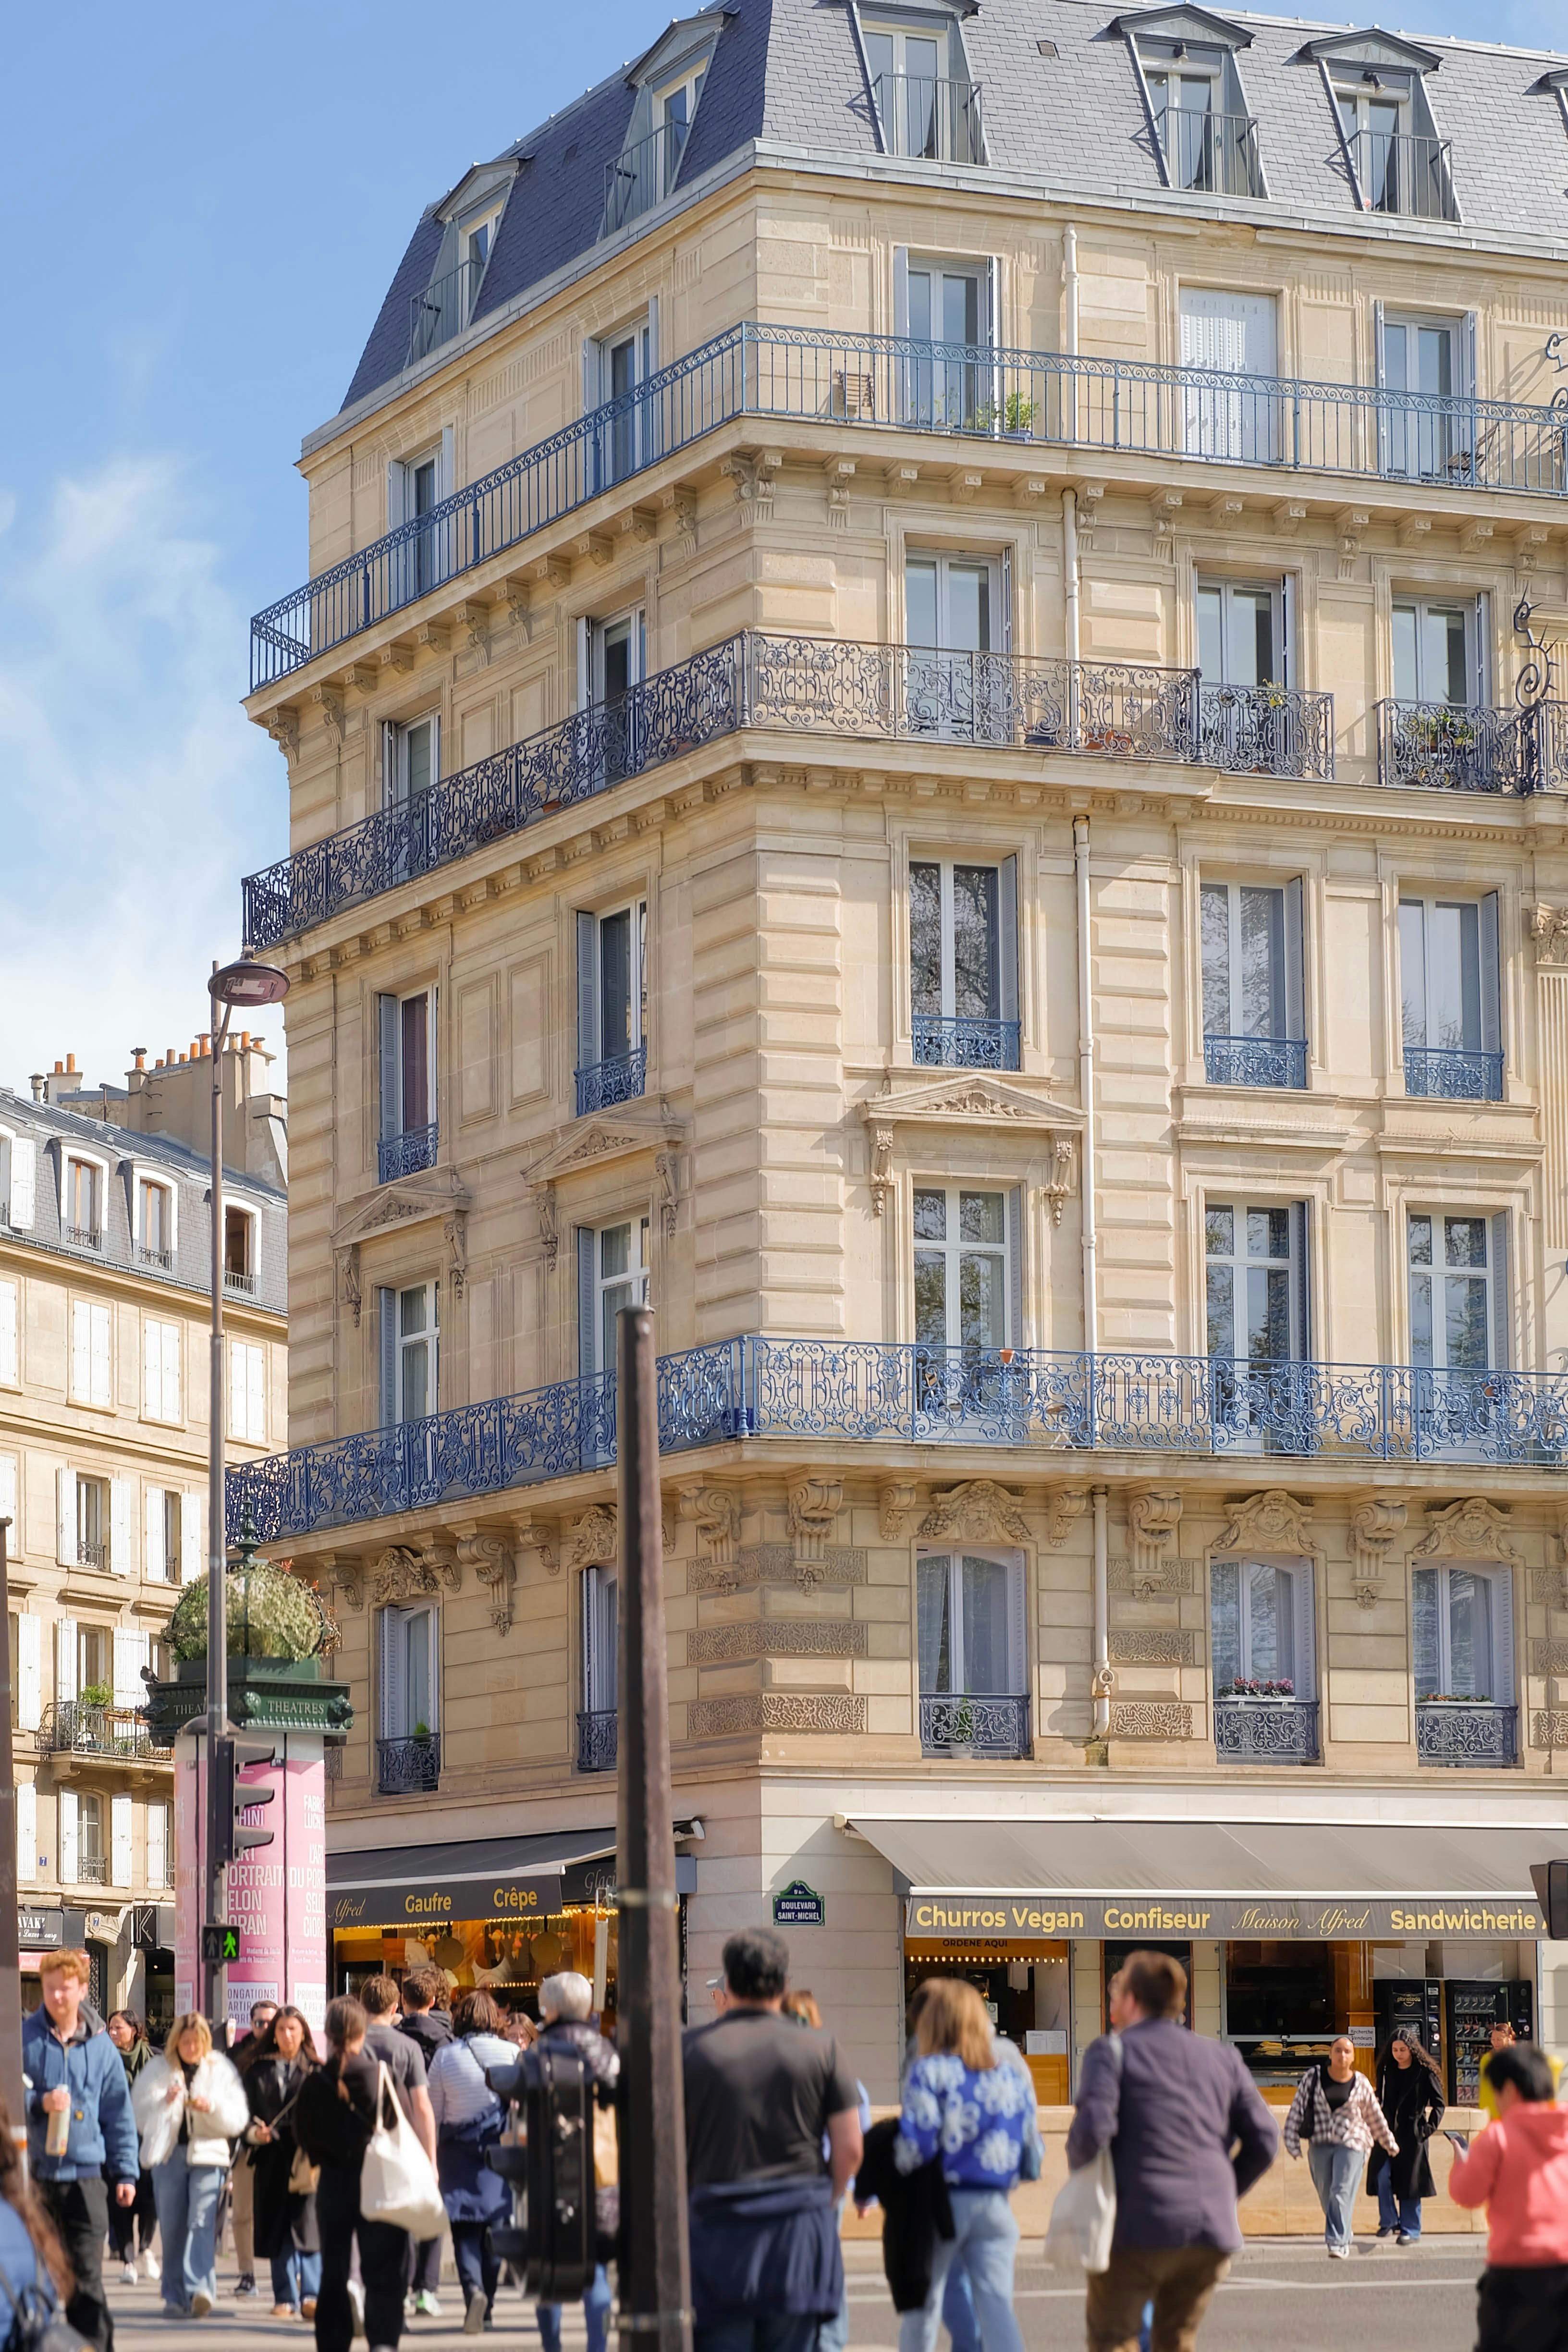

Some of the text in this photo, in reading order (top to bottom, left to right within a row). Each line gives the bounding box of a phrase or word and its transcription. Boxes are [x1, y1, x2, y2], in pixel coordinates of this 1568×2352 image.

[268, 1701, 324, 1715] THEATRES
[239, 1809, 264, 1826] HINI
[228, 1865, 283, 1886] ORTRAIT
[290, 1867, 305, 1888] DU
[585, 1869, 617, 1895] Glaci
[228, 1889, 262, 1911] ELON
[328, 1886, 538, 1924] Alfred Gaufre Crêpe
[781, 1901, 816, 1910] BOULEVARD
[136, 1908, 153, 1943] K
[228, 1914, 267, 1936] ORAN
[916, 1905, 1006, 1927] Churros
[1012, 1907, 1084, 1933] Vegan
[1104, 1906, 1211, 1929] Confiseur
[1232, 1908, 1303, 1929] Maison
[1307, 1908, 1370, 1936] Alfred
[1391, 1908, 1536, 1930] Sandwicherie
[984, 1940, 1007, 1948] AQUI
[228, 1988, 275, 1999] ONGATIONS
[229, 2001, 252, 2011] ARTIR
